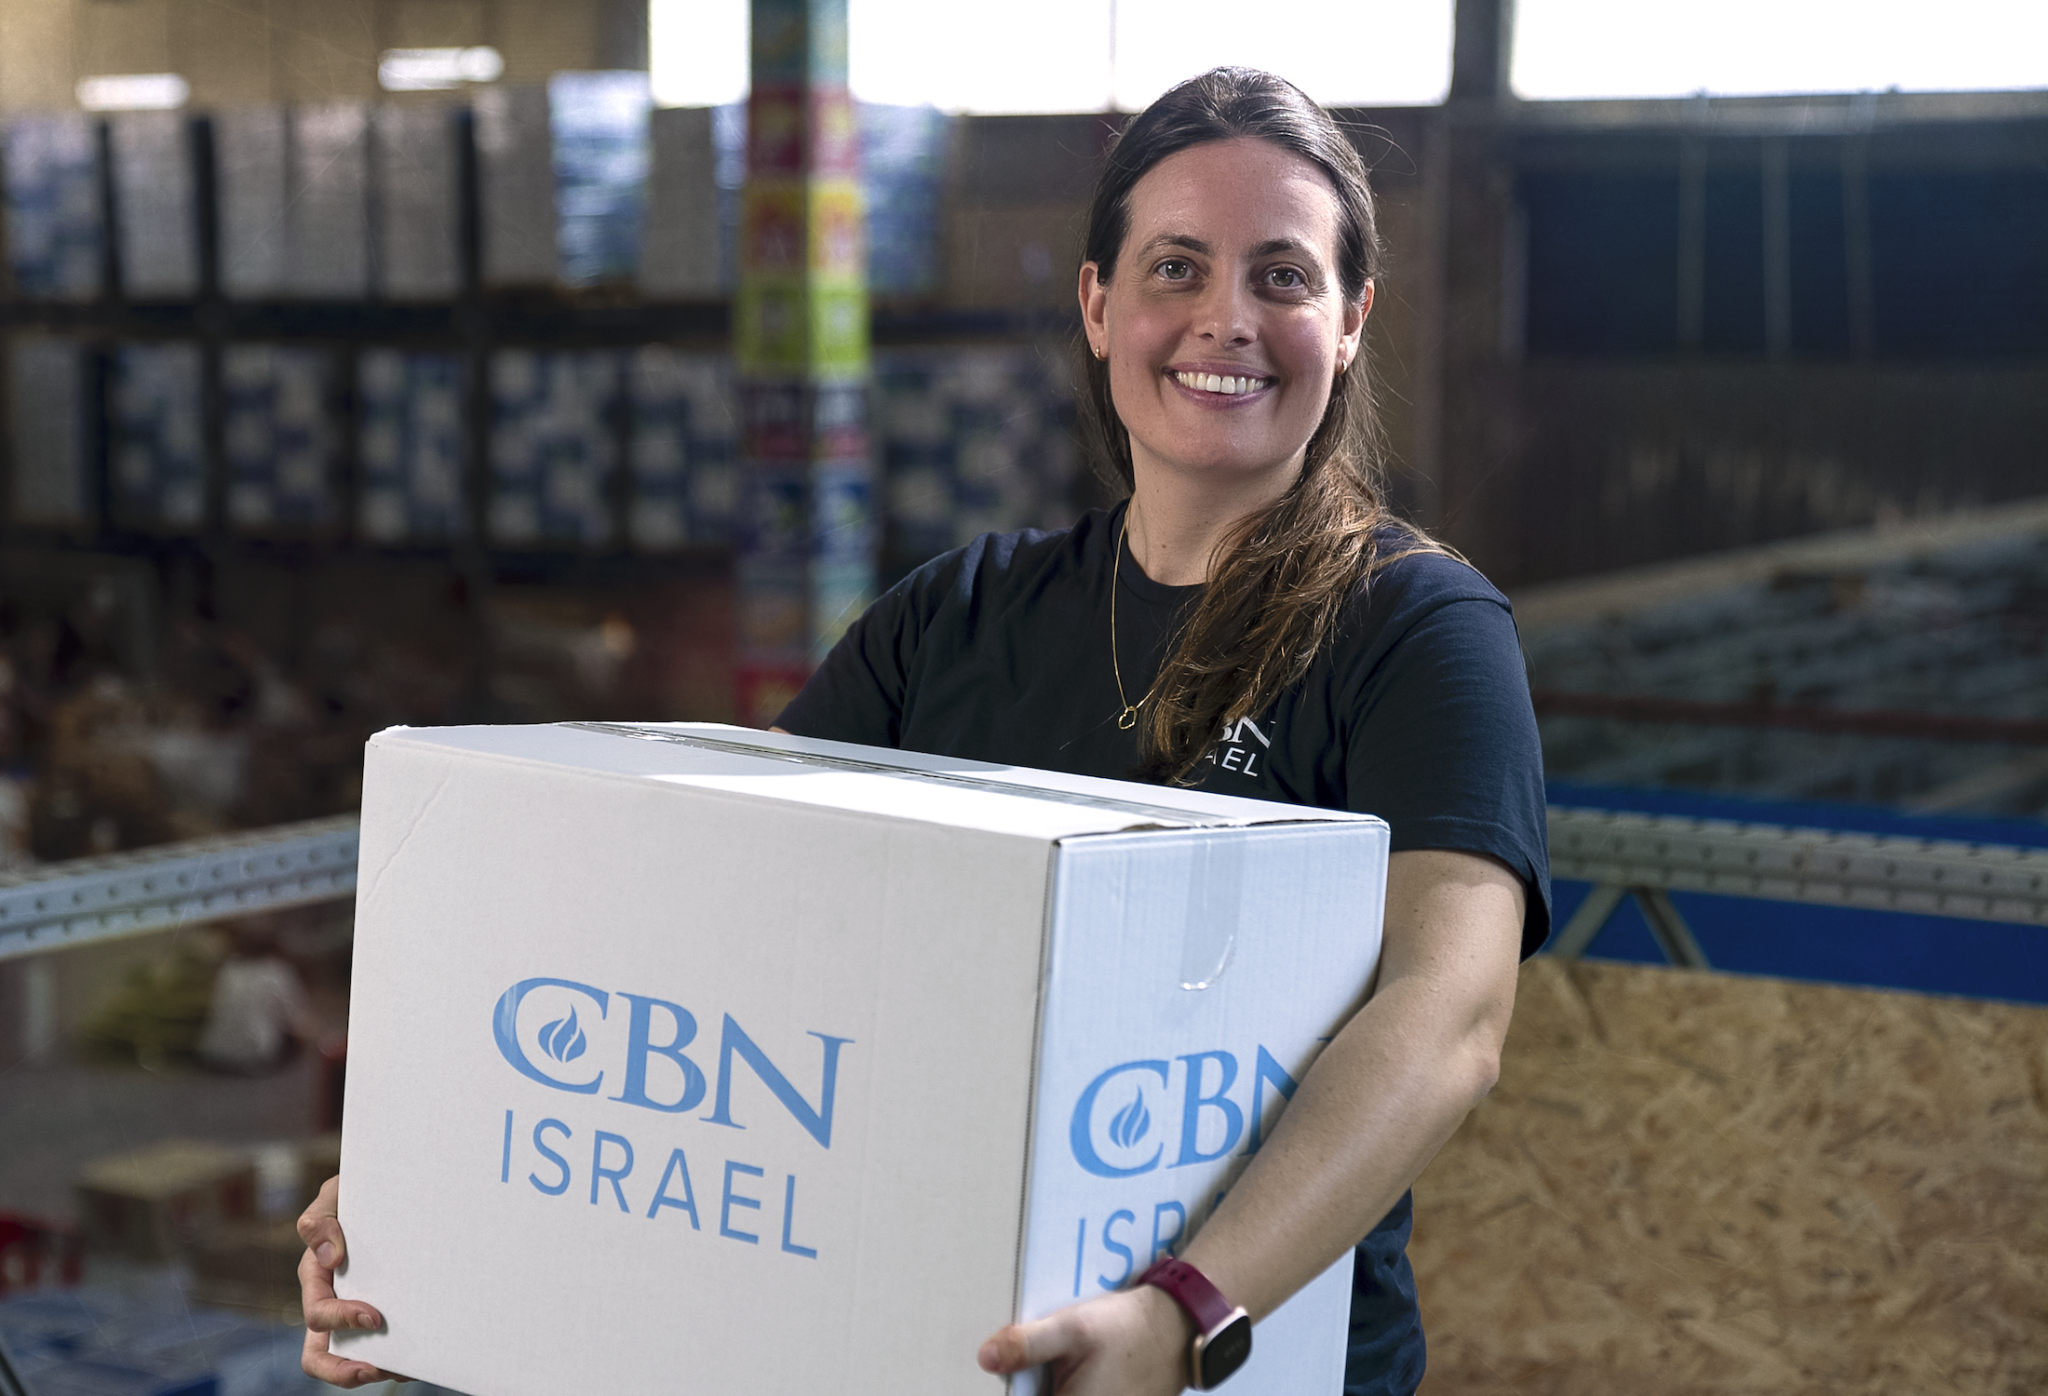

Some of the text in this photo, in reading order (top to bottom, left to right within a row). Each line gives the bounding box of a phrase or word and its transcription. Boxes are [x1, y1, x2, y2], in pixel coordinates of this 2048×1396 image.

[492, 977, 856, 1150] CBN
[501, 1109, 818, 1260] ISRAEL
[1073, 1192, 1226, 1298] ISR
